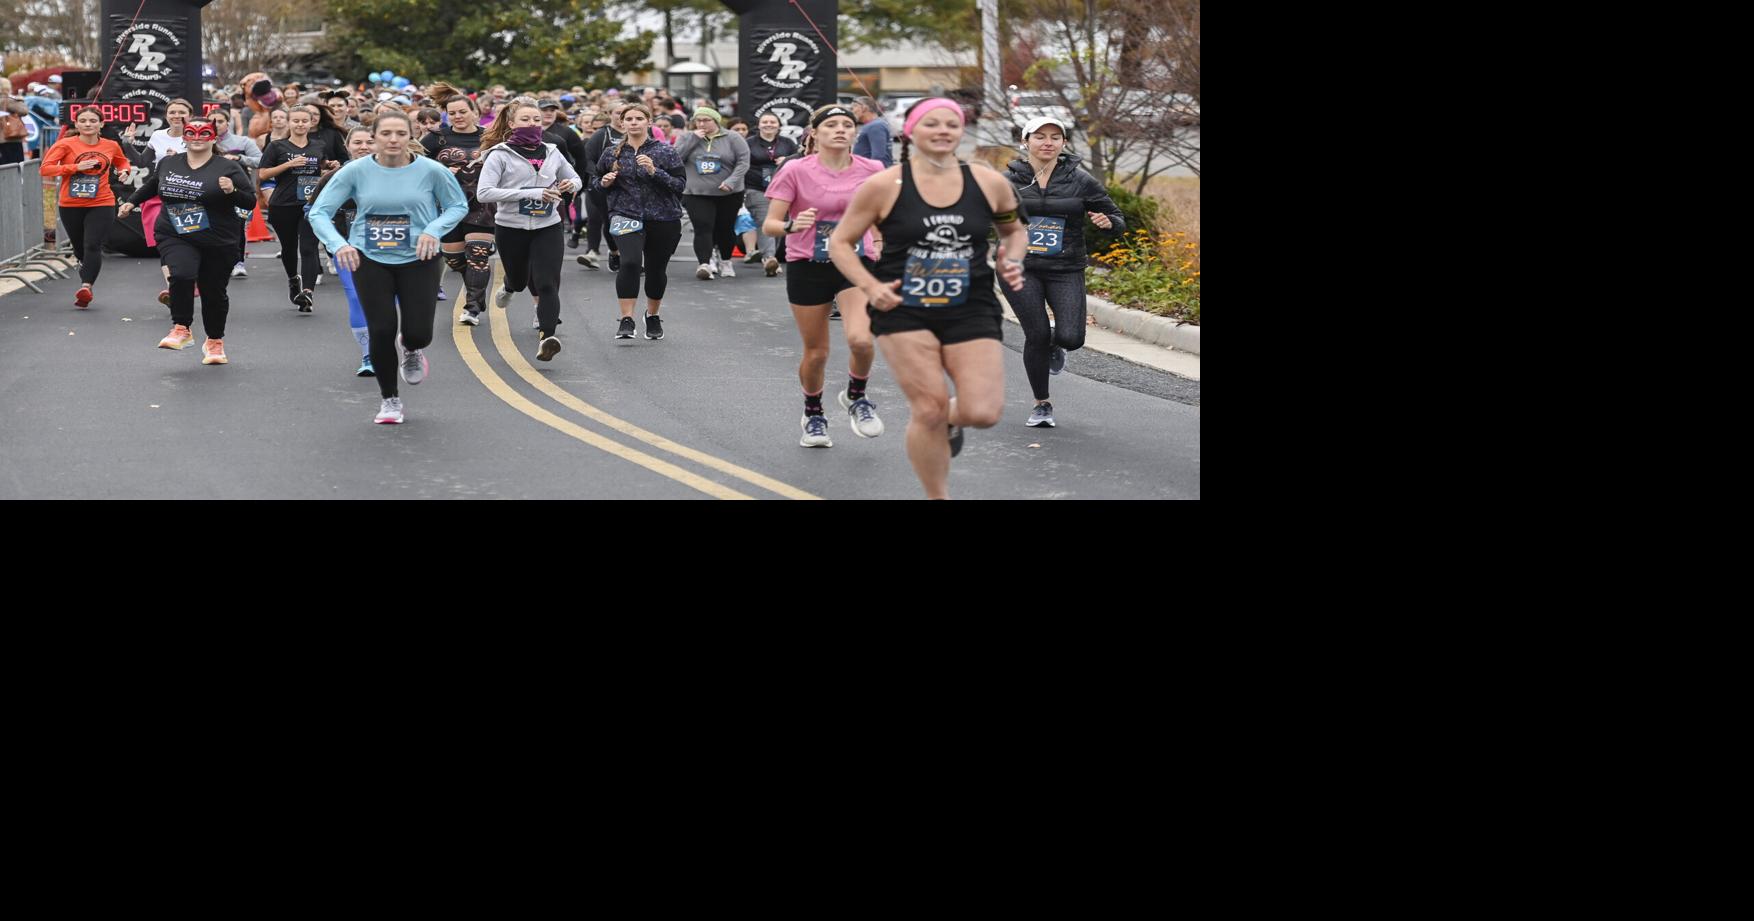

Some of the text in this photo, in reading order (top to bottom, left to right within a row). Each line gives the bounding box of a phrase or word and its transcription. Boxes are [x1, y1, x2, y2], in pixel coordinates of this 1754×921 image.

[115, 23, 180, 46] Riverside Runners
[757, 32, 820, 54] Riverside Runners
[160, 67, 172, 76] VA
[800, 75, 814, 83] VA
[148, 89, 170, 103] Runn
[701, 162, 716, 170] 89
[72, 183, 96, 193] 213
[165, 176, 203, 187] WOMAN
[174, 211, 204, 227] 147
[613, 220, 640, 231] 270
[369, 227, 406, 241] 355
[1027, 231, 1058, 247] 23
[908, 277, 963, 296] 203
